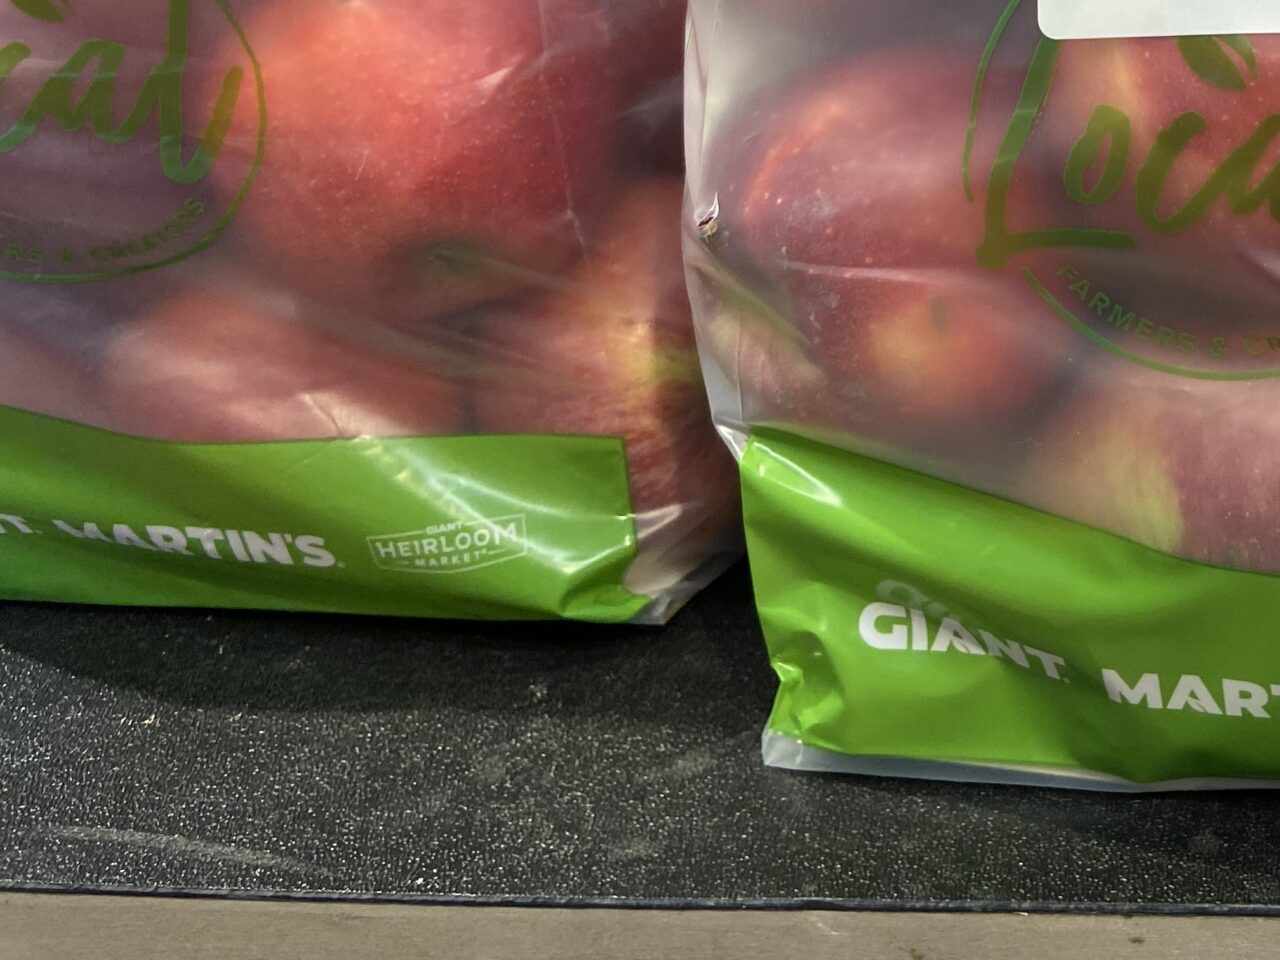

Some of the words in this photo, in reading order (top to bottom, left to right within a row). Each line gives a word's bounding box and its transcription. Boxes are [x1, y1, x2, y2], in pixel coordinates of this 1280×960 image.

[1055, 264, 1197, 356] FARMERS
[1208, 336, 1229, 358] &
[375, 521, 517, 558] HEIRLOOM
[414, 550, 484, 567] MARKET
[858, 602, 1066, 682] GIANT
